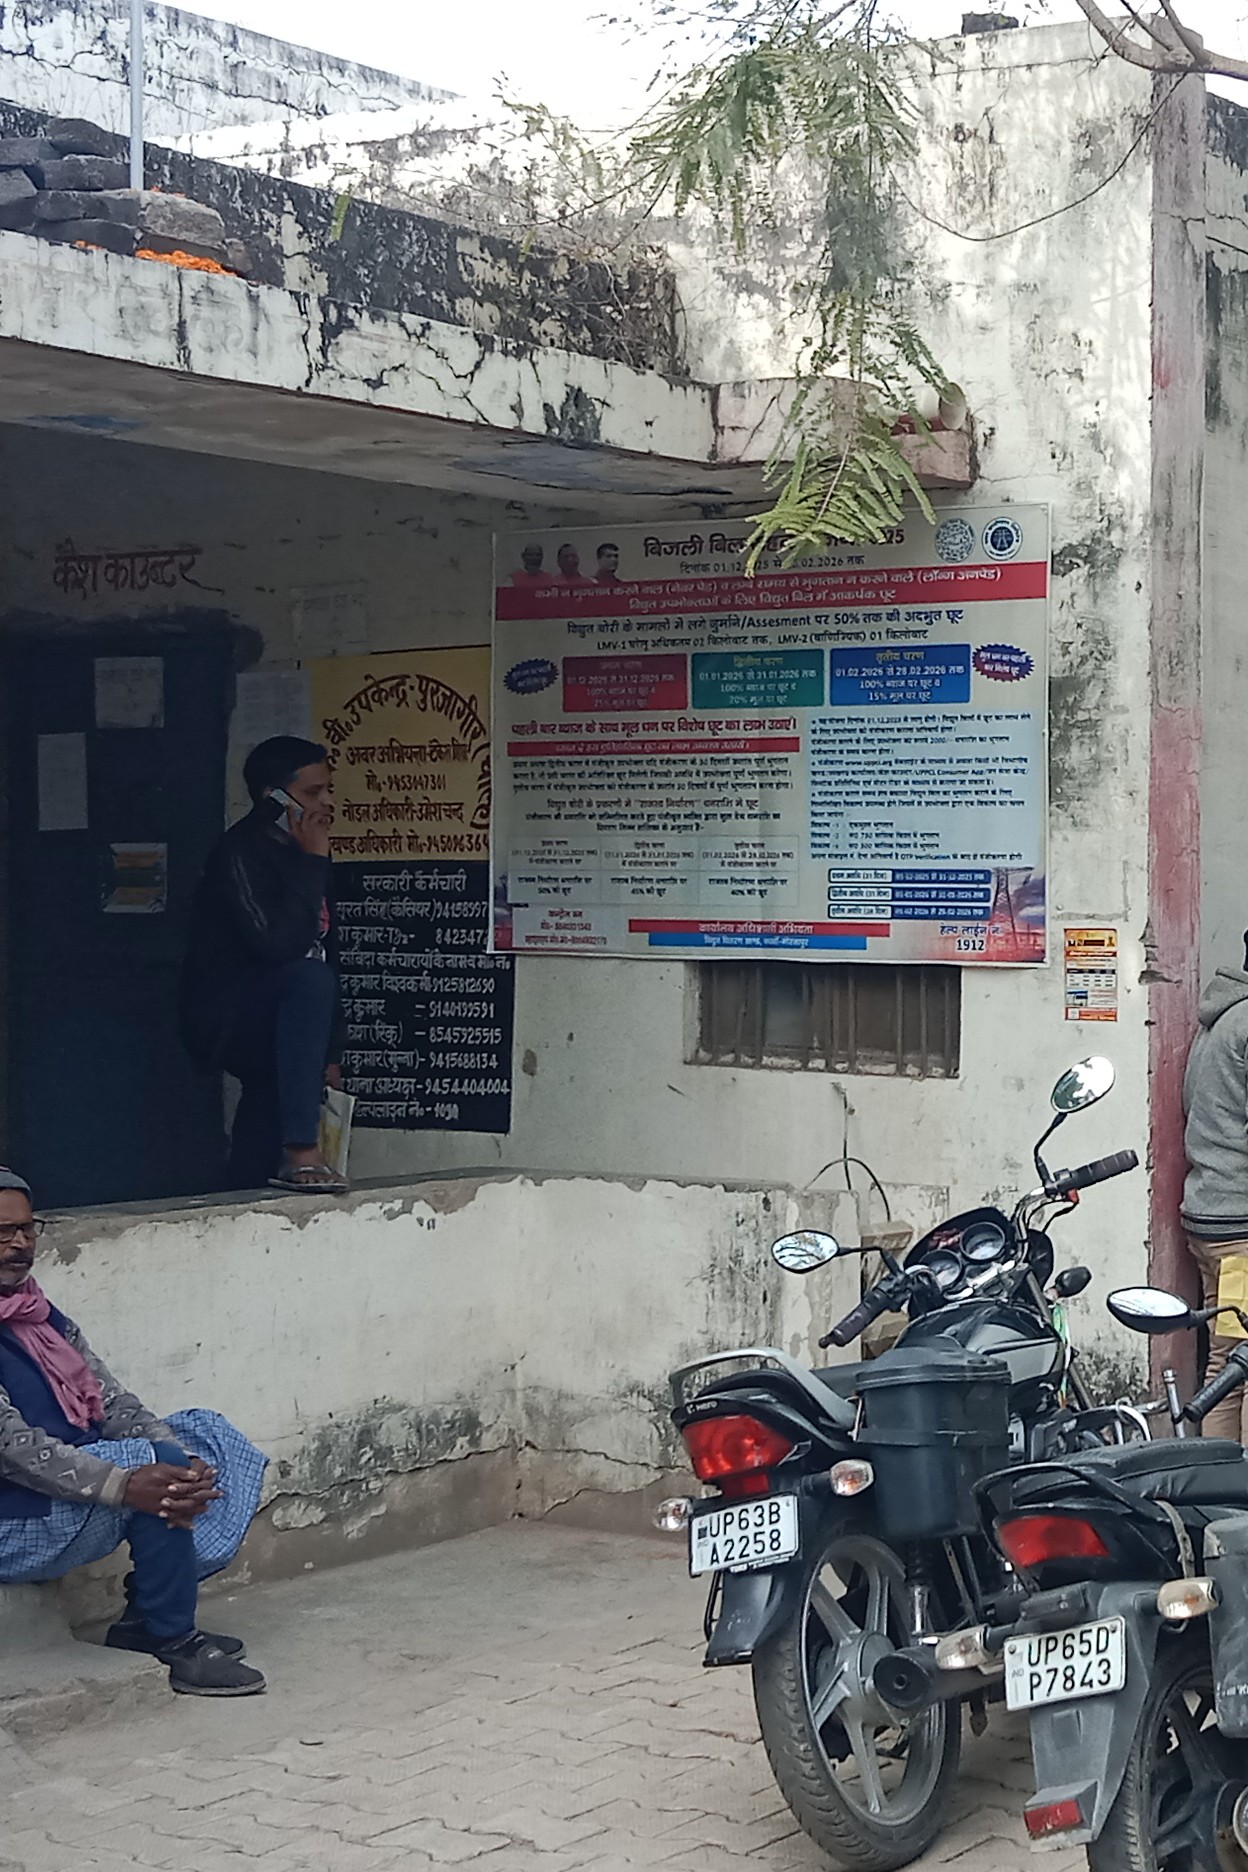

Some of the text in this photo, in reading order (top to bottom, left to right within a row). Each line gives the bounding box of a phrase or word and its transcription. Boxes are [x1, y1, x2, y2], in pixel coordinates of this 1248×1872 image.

[644, 533, 703, 558] बिजली
[890, 570, 914, 583] वाले
[814, 614, 831, 625] पर
[834, 609, 860, 624] 50%
[862, 610, 882, 623] तक
[885, 607, 901, 622] की
[778, 632, 808, 645] LMV-2
[869, 630, 883, 642] 01
[662, 719, 677, 733] पर
[346, 745, 375, 766] अवर
[363, 869, 414, 892] सरकारी
[956, 939, 985, 951] 1912
[429, 1027, 502, 1045] 8545925515
[429, 1052, 499, 1070] 9415688134
[709, 1501, 781, 1538] UP63B
[710, 1529, 782, 1566] A2258
[1027, 1626, 1110, 1667] UP65D
[1028, 1658, 1112, 1701] P7843
